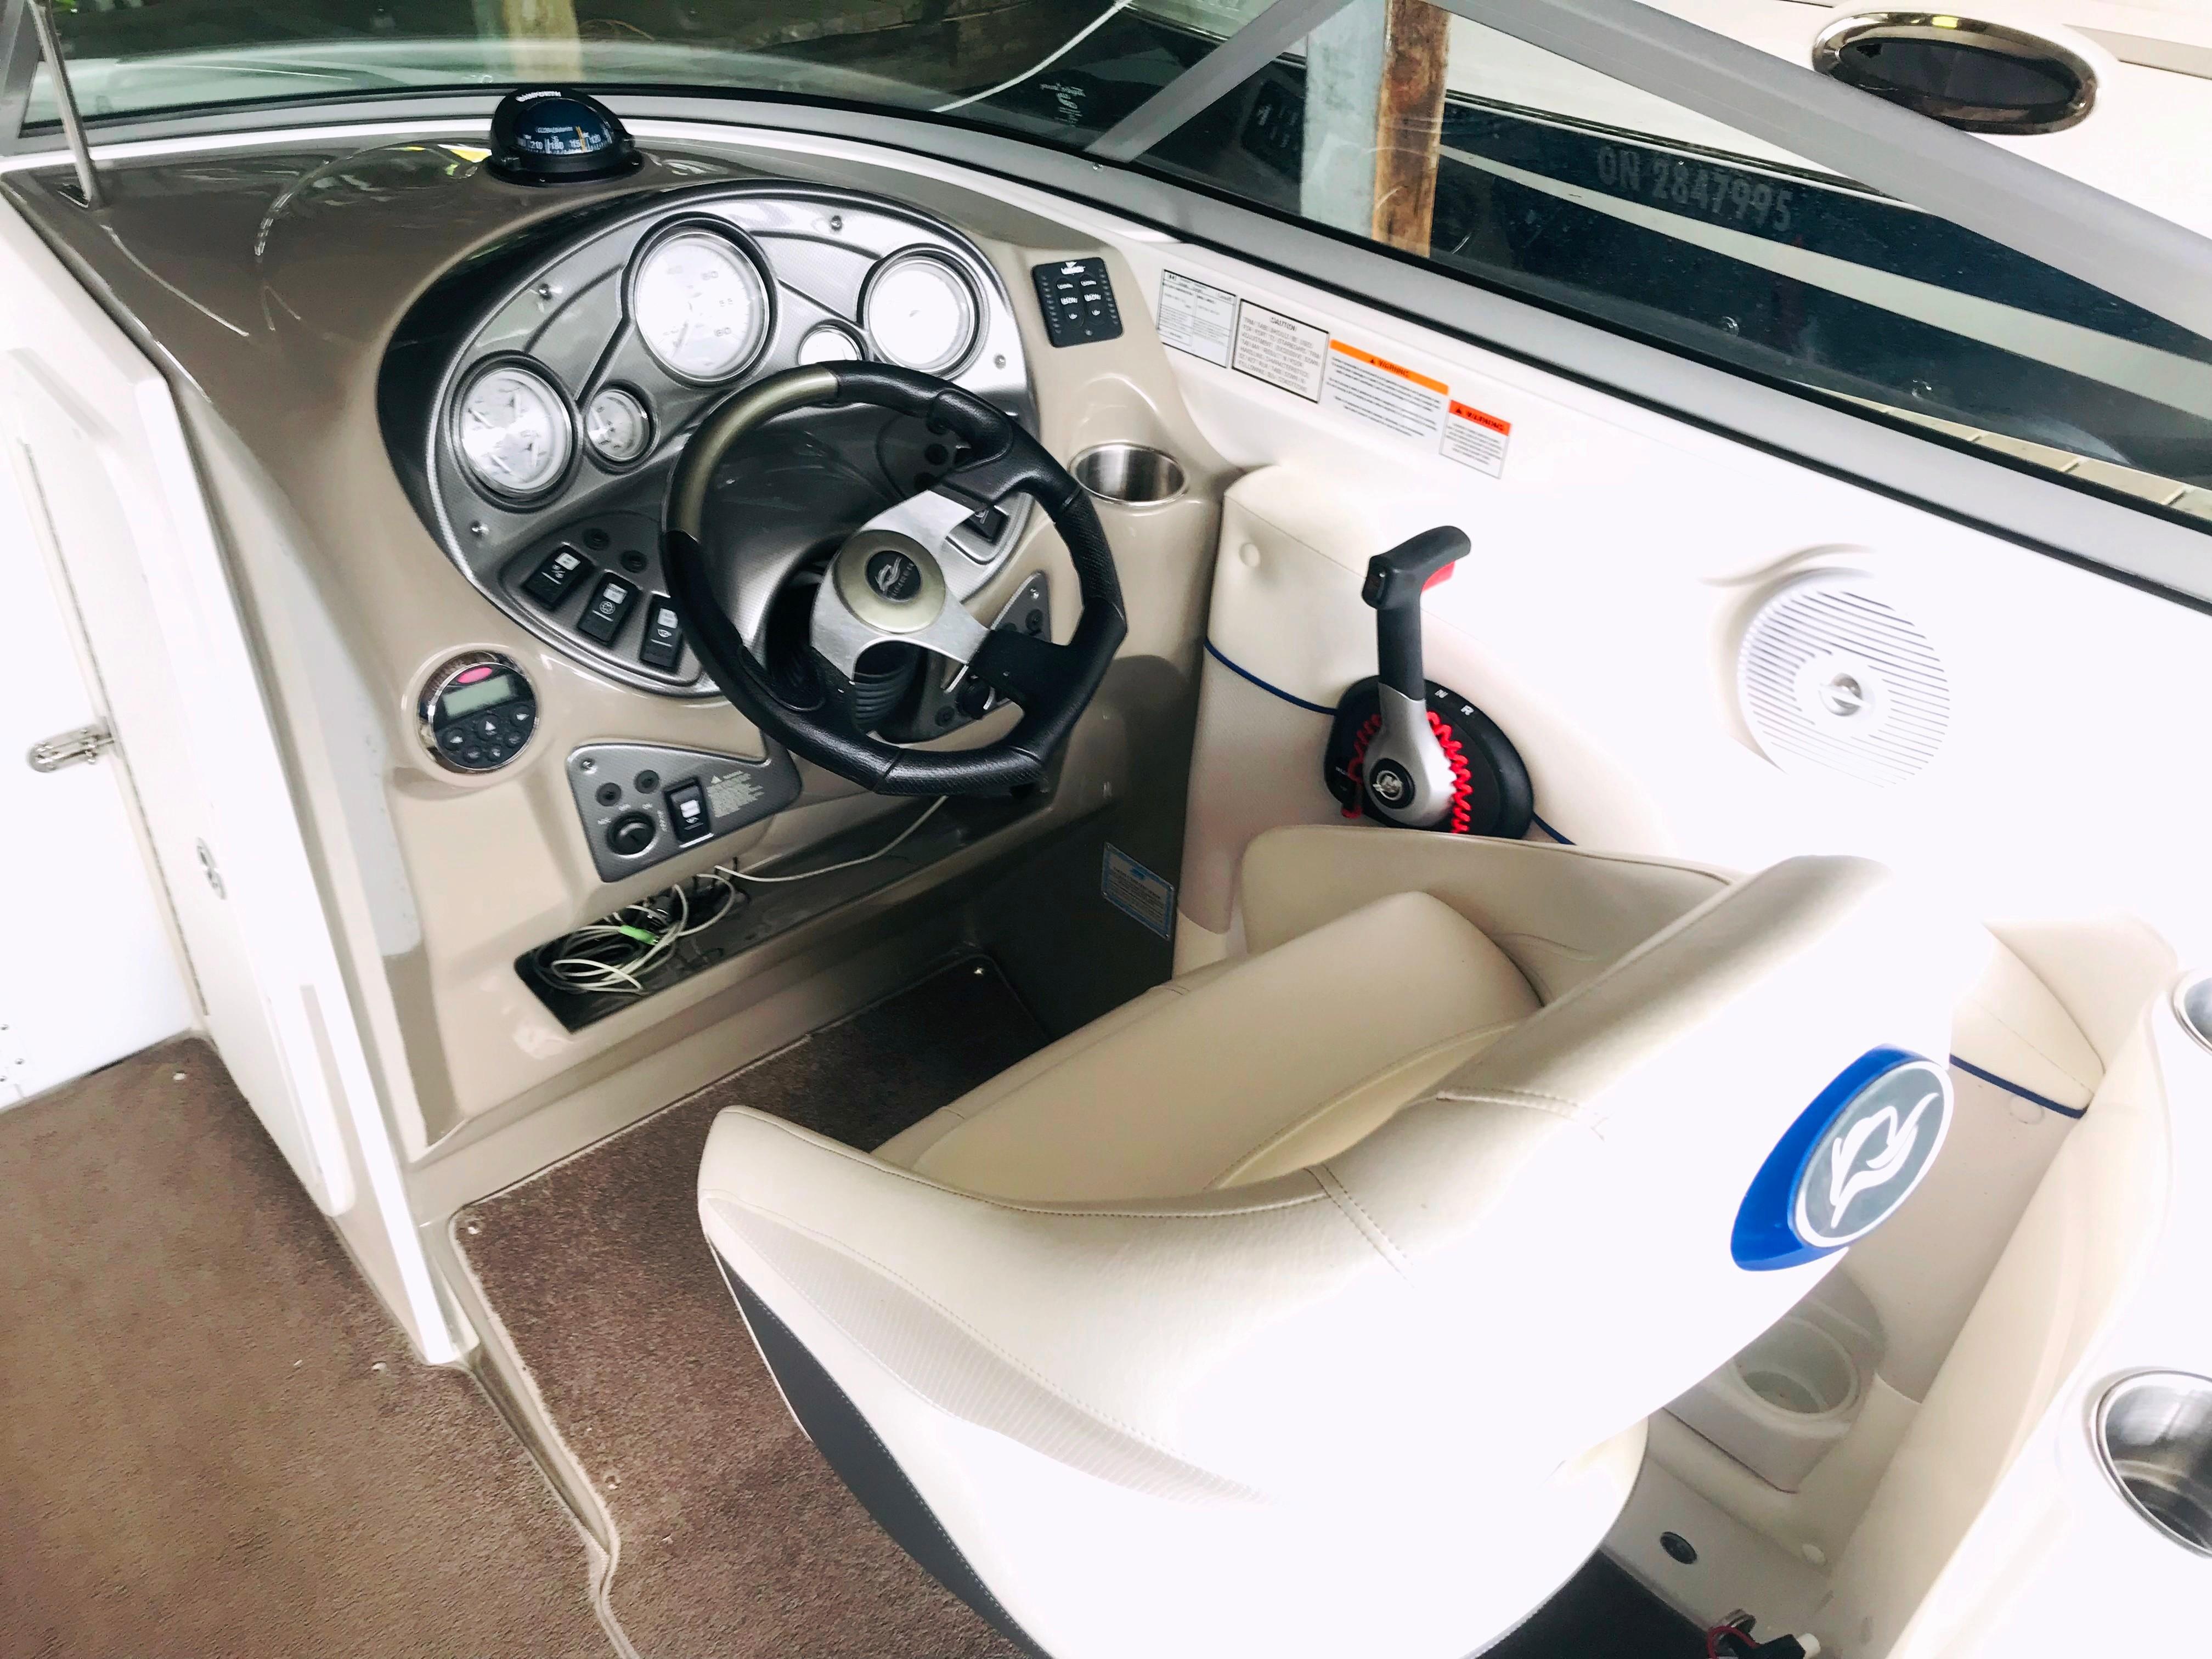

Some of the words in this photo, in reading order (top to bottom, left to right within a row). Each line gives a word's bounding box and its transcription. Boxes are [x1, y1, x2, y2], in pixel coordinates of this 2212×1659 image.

[1596, 145, 1640, 192] ON
[1651, 157, 1794, 233] 2847995
[1271, 317, 1296, 331] CAUTION
[1379, 360, 1408, 377] WARNING
[1435, 689, 1449, 698] N
[1460, 705, 1475, 716] R
